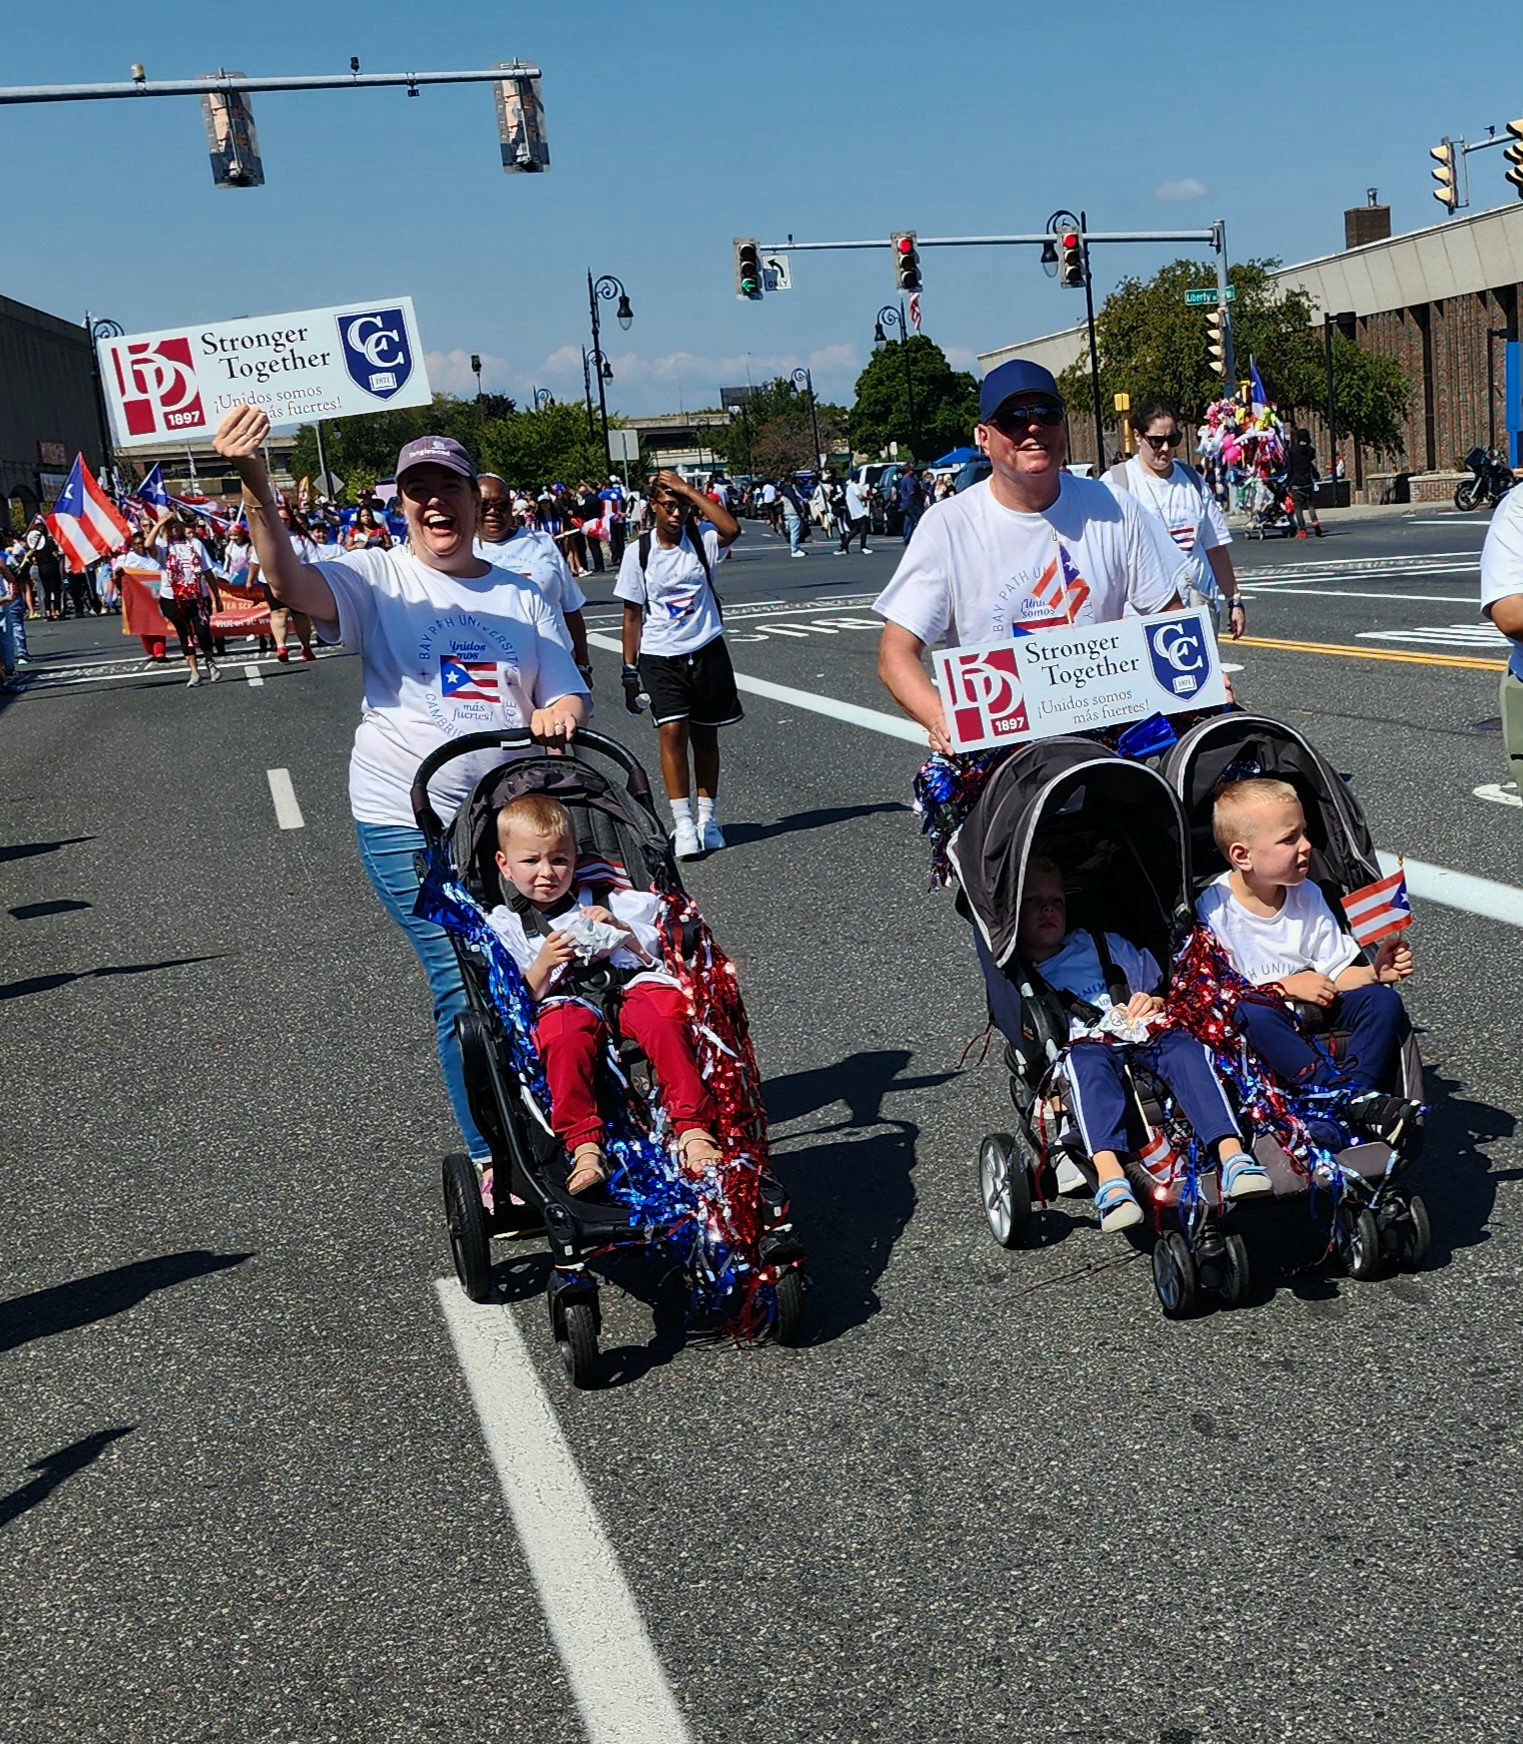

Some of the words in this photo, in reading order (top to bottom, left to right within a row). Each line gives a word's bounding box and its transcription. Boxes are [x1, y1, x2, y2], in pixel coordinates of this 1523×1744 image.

[1186, 292, 1211, 303] Liberty
[201, 325, 309, 356] Stronger
[347, 315, 405, 368] CC
[218, 347, 331, 384] Together
[268, 404, 284, 419] ás
[287, 395, 343, 417] fuertes!
[276, 386, 323, 402] somos
[168, 411, 200, 427] 1897
[998, 570, 1030, 601] PATH
[992, 604, 1005, 632] BAY
[1022, 608, 1056, 619] somos
[419, 633, 433, 660] BAY
[1025, 634, 1120, 664] Stronger
[1153, 623, 1204, 671] CC
[1041, 655, 1140, 688] Together
[463, 701, 485, 712] más
[1037, 695, 1090, 719] ¡Unidos
[1092, 690, 1133, 706] somos
[1073, 708, 1100, 724] más
[1102, 698, 1151, 719] fuertes!
[995, 717, 1025, 732] 1897
